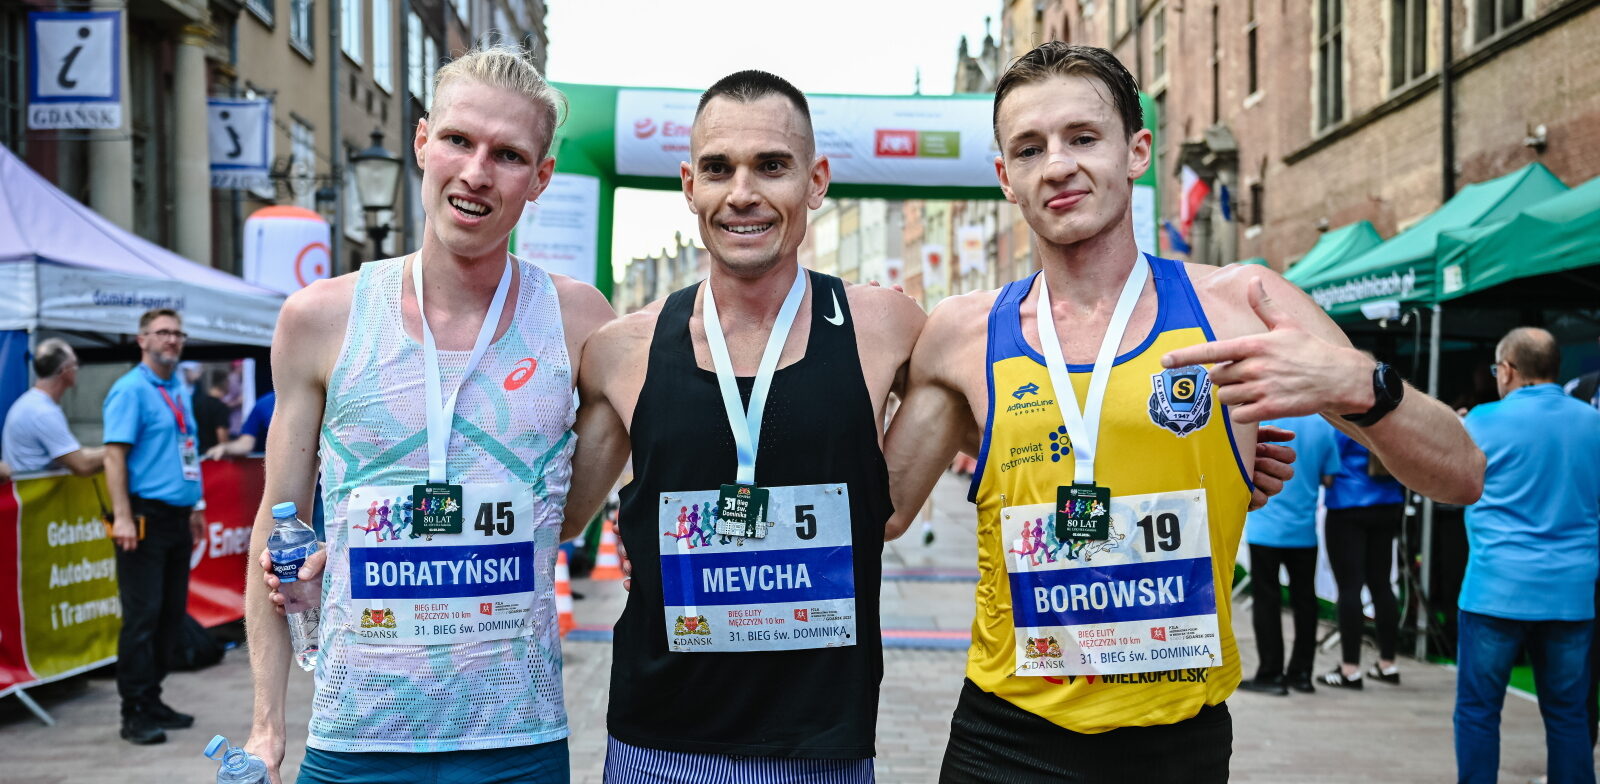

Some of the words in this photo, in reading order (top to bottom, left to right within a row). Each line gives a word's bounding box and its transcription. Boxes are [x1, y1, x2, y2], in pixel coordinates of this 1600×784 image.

[33, 106, 114, 125] GDAŃSK
[1177, 380, 1191, 397] S
[1014, 407, 1046, 416] SPORTS
[1010, 442, 1043, 457] Powiat
[1000, 453, 1044, 473] Ostrowski
[723, 496, 737, 510] 31
[736, 499, 749, 508] Bieg
[423, 515, 434, 524] 80
[436, 515, 452, 524] LAT
[474, 501, 515, 537] 45
[722, 509, 747, 519] Dominika
[794, 504, 817, 540] 5
[1066, 519, 1078, 528] 80
[1080, 519, 1098, 528] LAT
[1136, 512, 1181, 553] 19
[49, 556, 117, 589] Autobusy
[364, 553, 521, 588] BORATYŃSKI
[702, 563, 813, 594] MEVCHA
[1034, 576, 1185, 614] BOROWSKI
[414, 604, 430, 612] BIEG
[431, 603, 449, 611] ELITY
[414, 610, 450, 621] MĘŻCZYZN
[461, 611, 472, 619] km
[728, 610, 744, 618] BIEG
[745, 609, 762, 617] ELITY
[51, 604, 59, 630] i
[728, 616, 763, 627] MĘŻCZYZN
[765, 617, 774, 625] 10
[775, 616, 785, 624] km
[360, 629, 399, 639] GDAŃSK
[414, 625, 430, 636] 31.
[433, 624, 457, 635] BIEG
[459, 623, 475, 633] św.
[478, 618, 525, 632] DOMINIKA
[729, 631, 745, 642] 31.
[748, 630, 771, 641] BIEG
[774, 629, 790, 640] św.
[793, 625, 847, 639] DOMINIKA
[1078, 629, 1095, 638] BIEG
[1096, 628, 1115, 637] ELITY
[673, 635, 713, 646] GDAŃSK
[1078, 638, 1117, 649] MĘŻCZYZN
[1119, 637, 1128, 646] 10
[1129, 636, 1141, 645] km
[1080, 653, 1097, 665] 31.
[1100, 651, 1126, 663] BIEG
[1129, 650, 1147, 662] św.
[1151, 644, 1210, 660] DOMINIKA
[1022, 659, 1065, 670] GDAŃSK
[1101, 667, 1208, 684] WIELKOPOLSK
